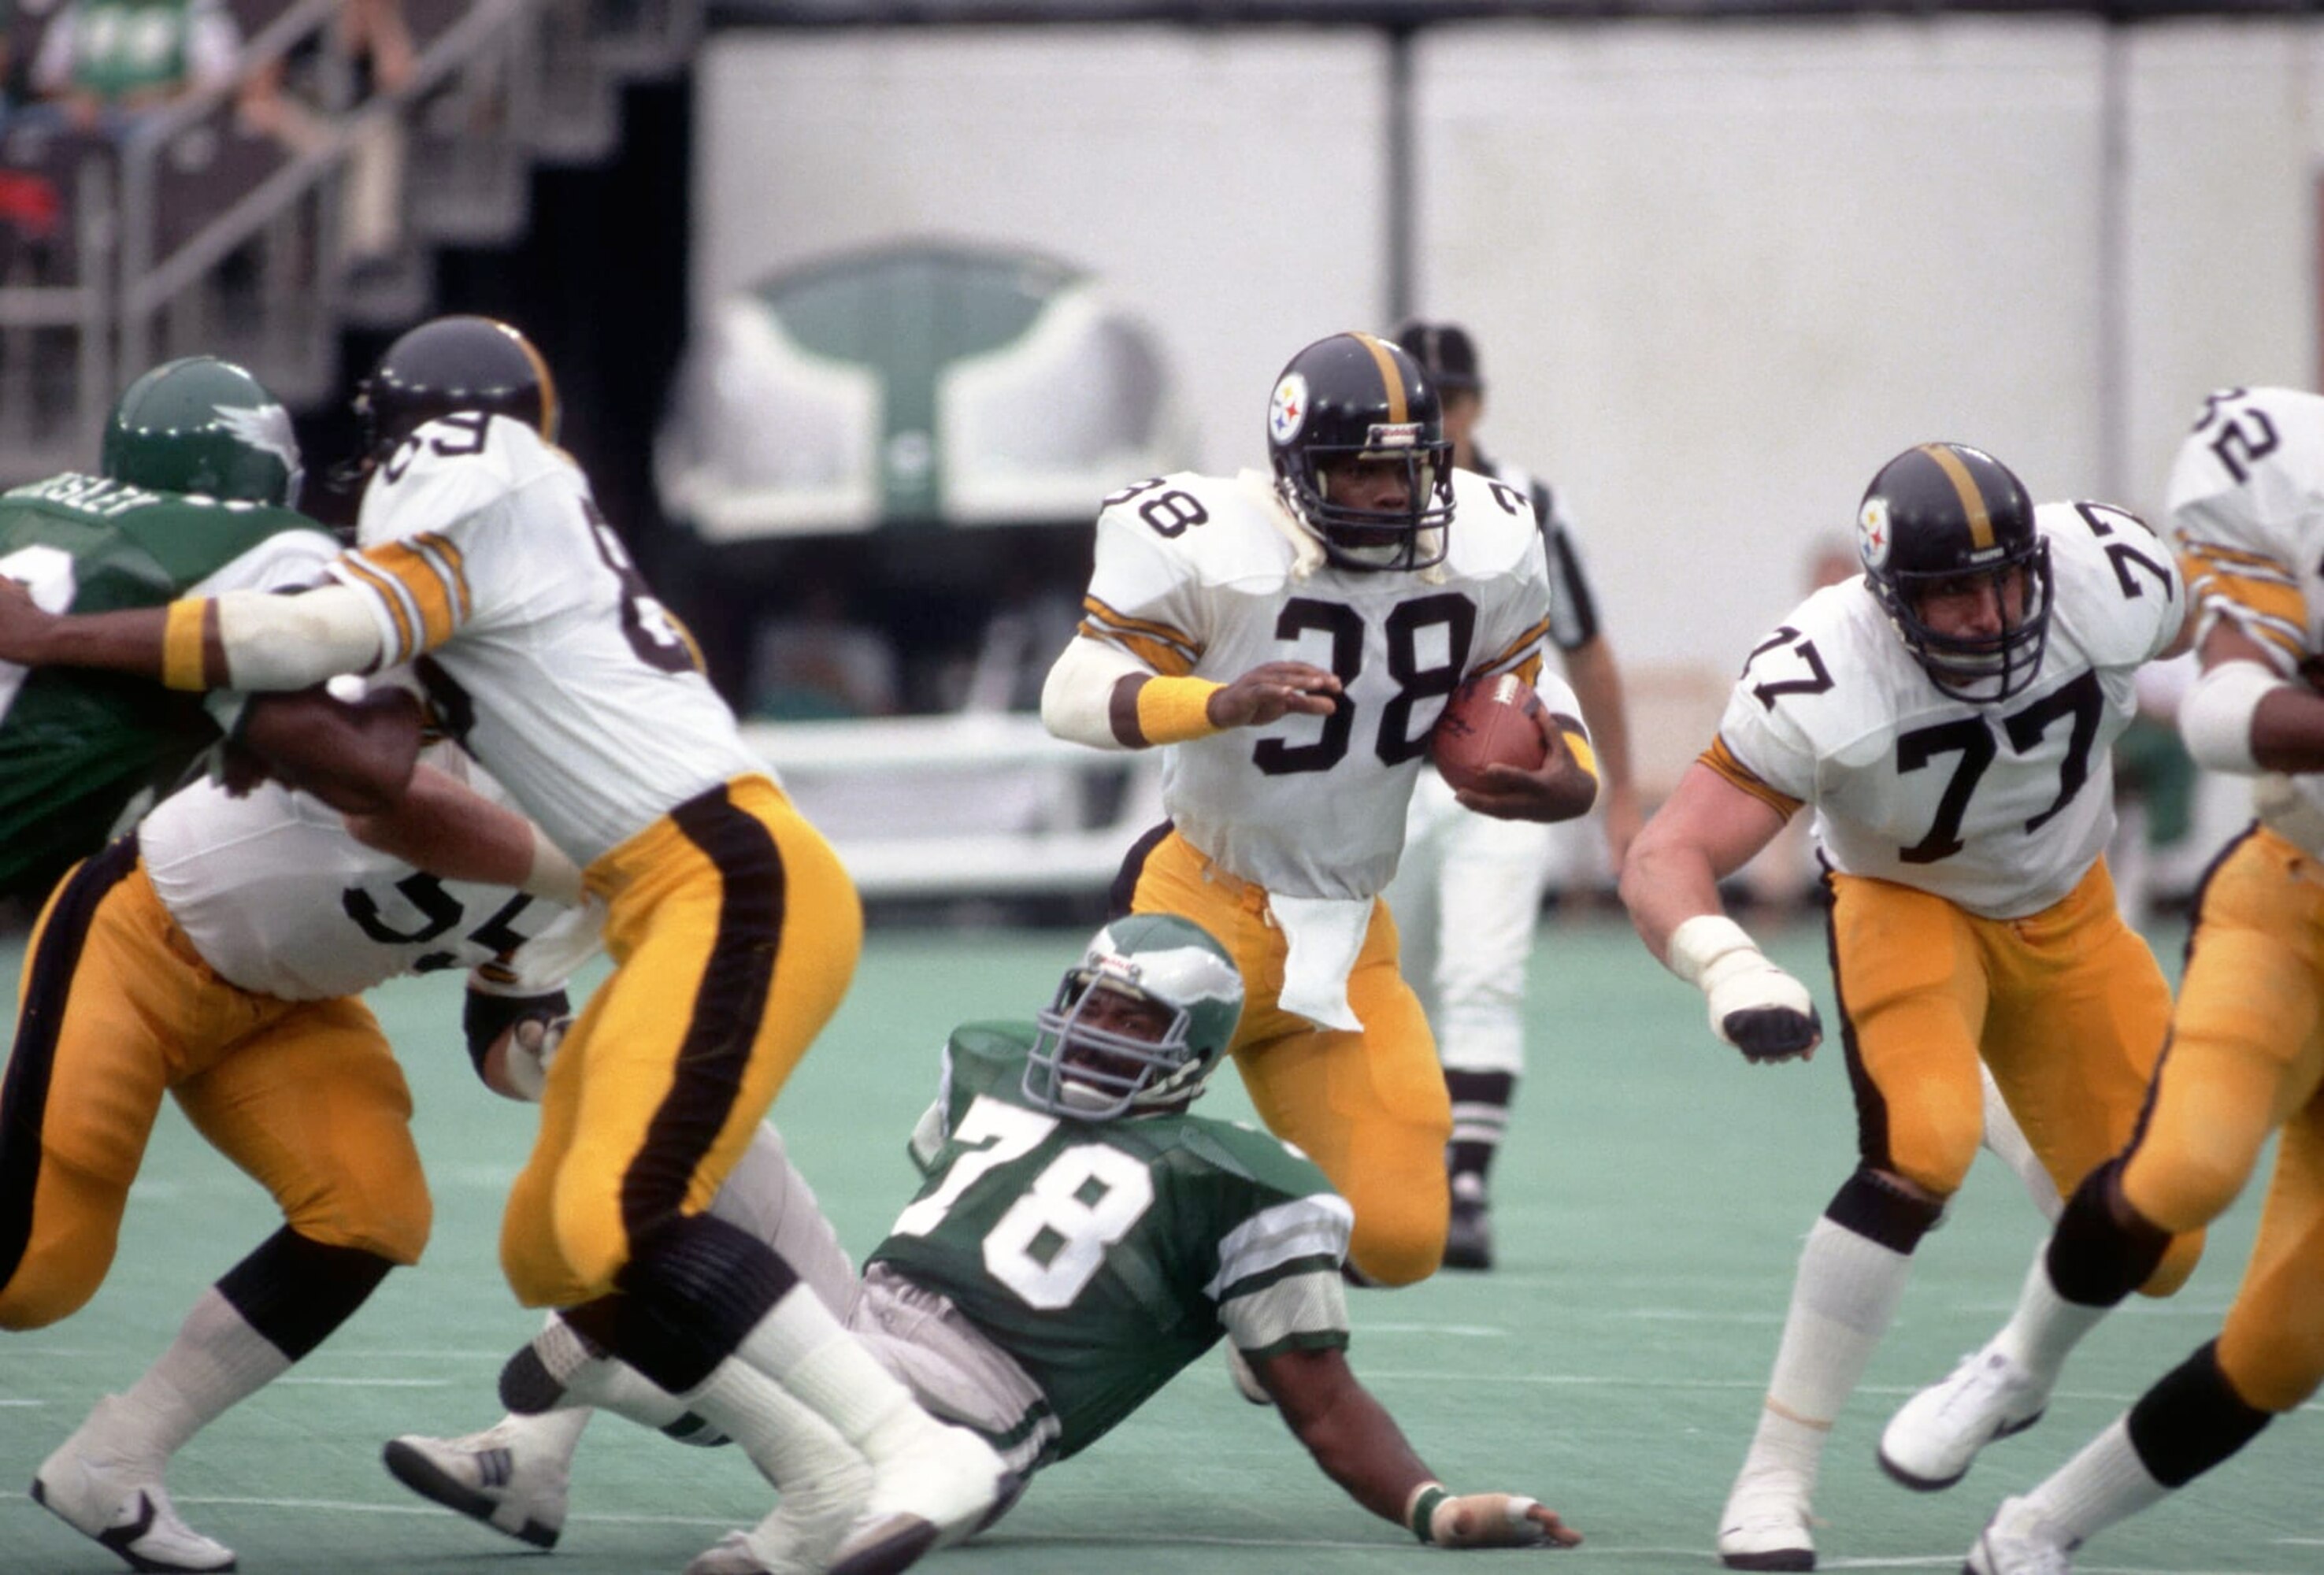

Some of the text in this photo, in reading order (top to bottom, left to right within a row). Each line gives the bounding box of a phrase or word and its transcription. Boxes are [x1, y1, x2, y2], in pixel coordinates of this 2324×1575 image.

[2074, 502, 2173, 603] 77
[1253, 592, 1477, 776] 38
[1739, 626, 1836, 713] 77
[1897, 668, 2105, 864] 77
[890, 1094, 1155, 1310] 78
